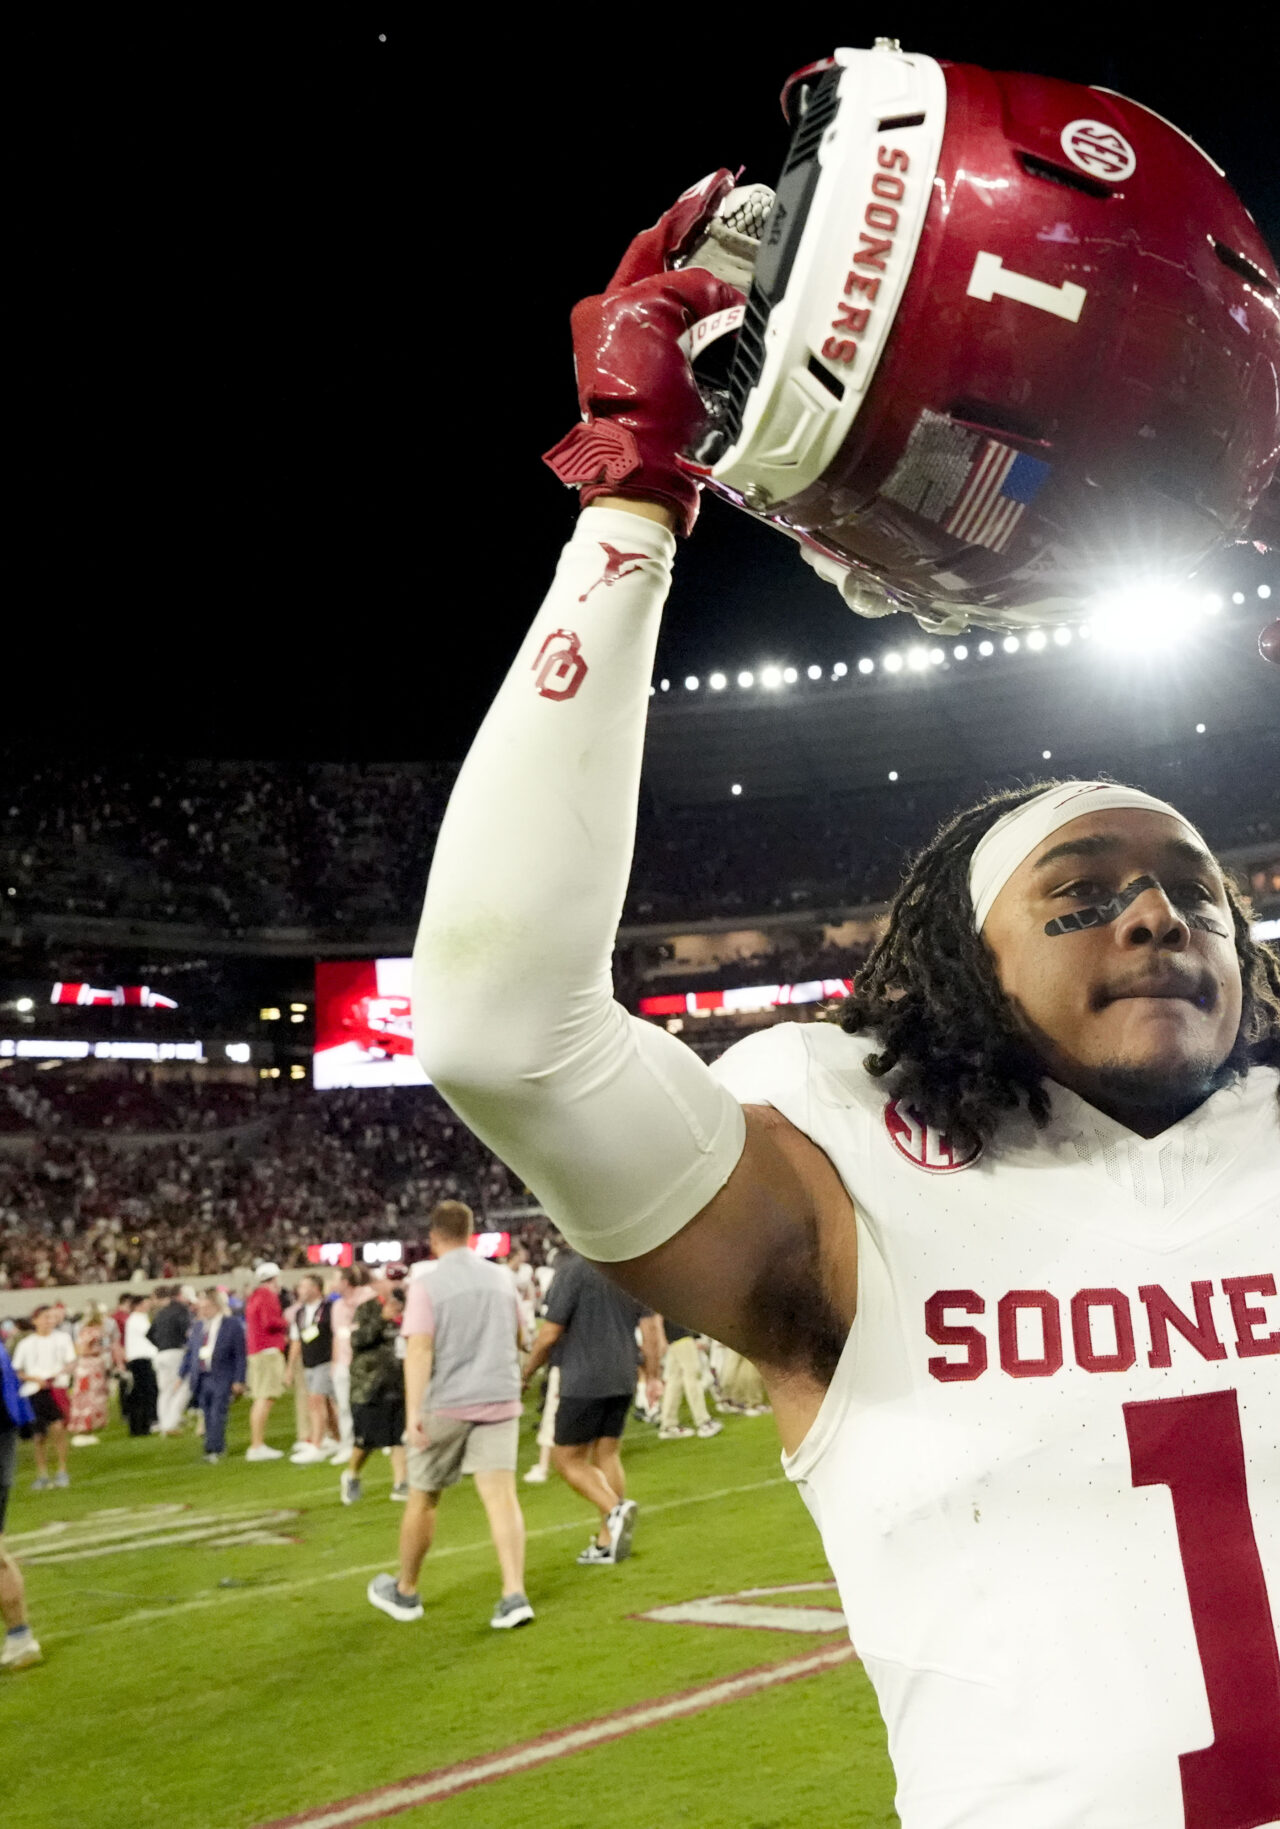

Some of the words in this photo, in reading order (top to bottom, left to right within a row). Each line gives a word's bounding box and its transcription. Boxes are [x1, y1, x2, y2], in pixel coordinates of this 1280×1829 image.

[1061, 119, 1136, 181] SEC
[821, 145, 910, 364] SOONERS
[966, 250, 1087, 323] 1
